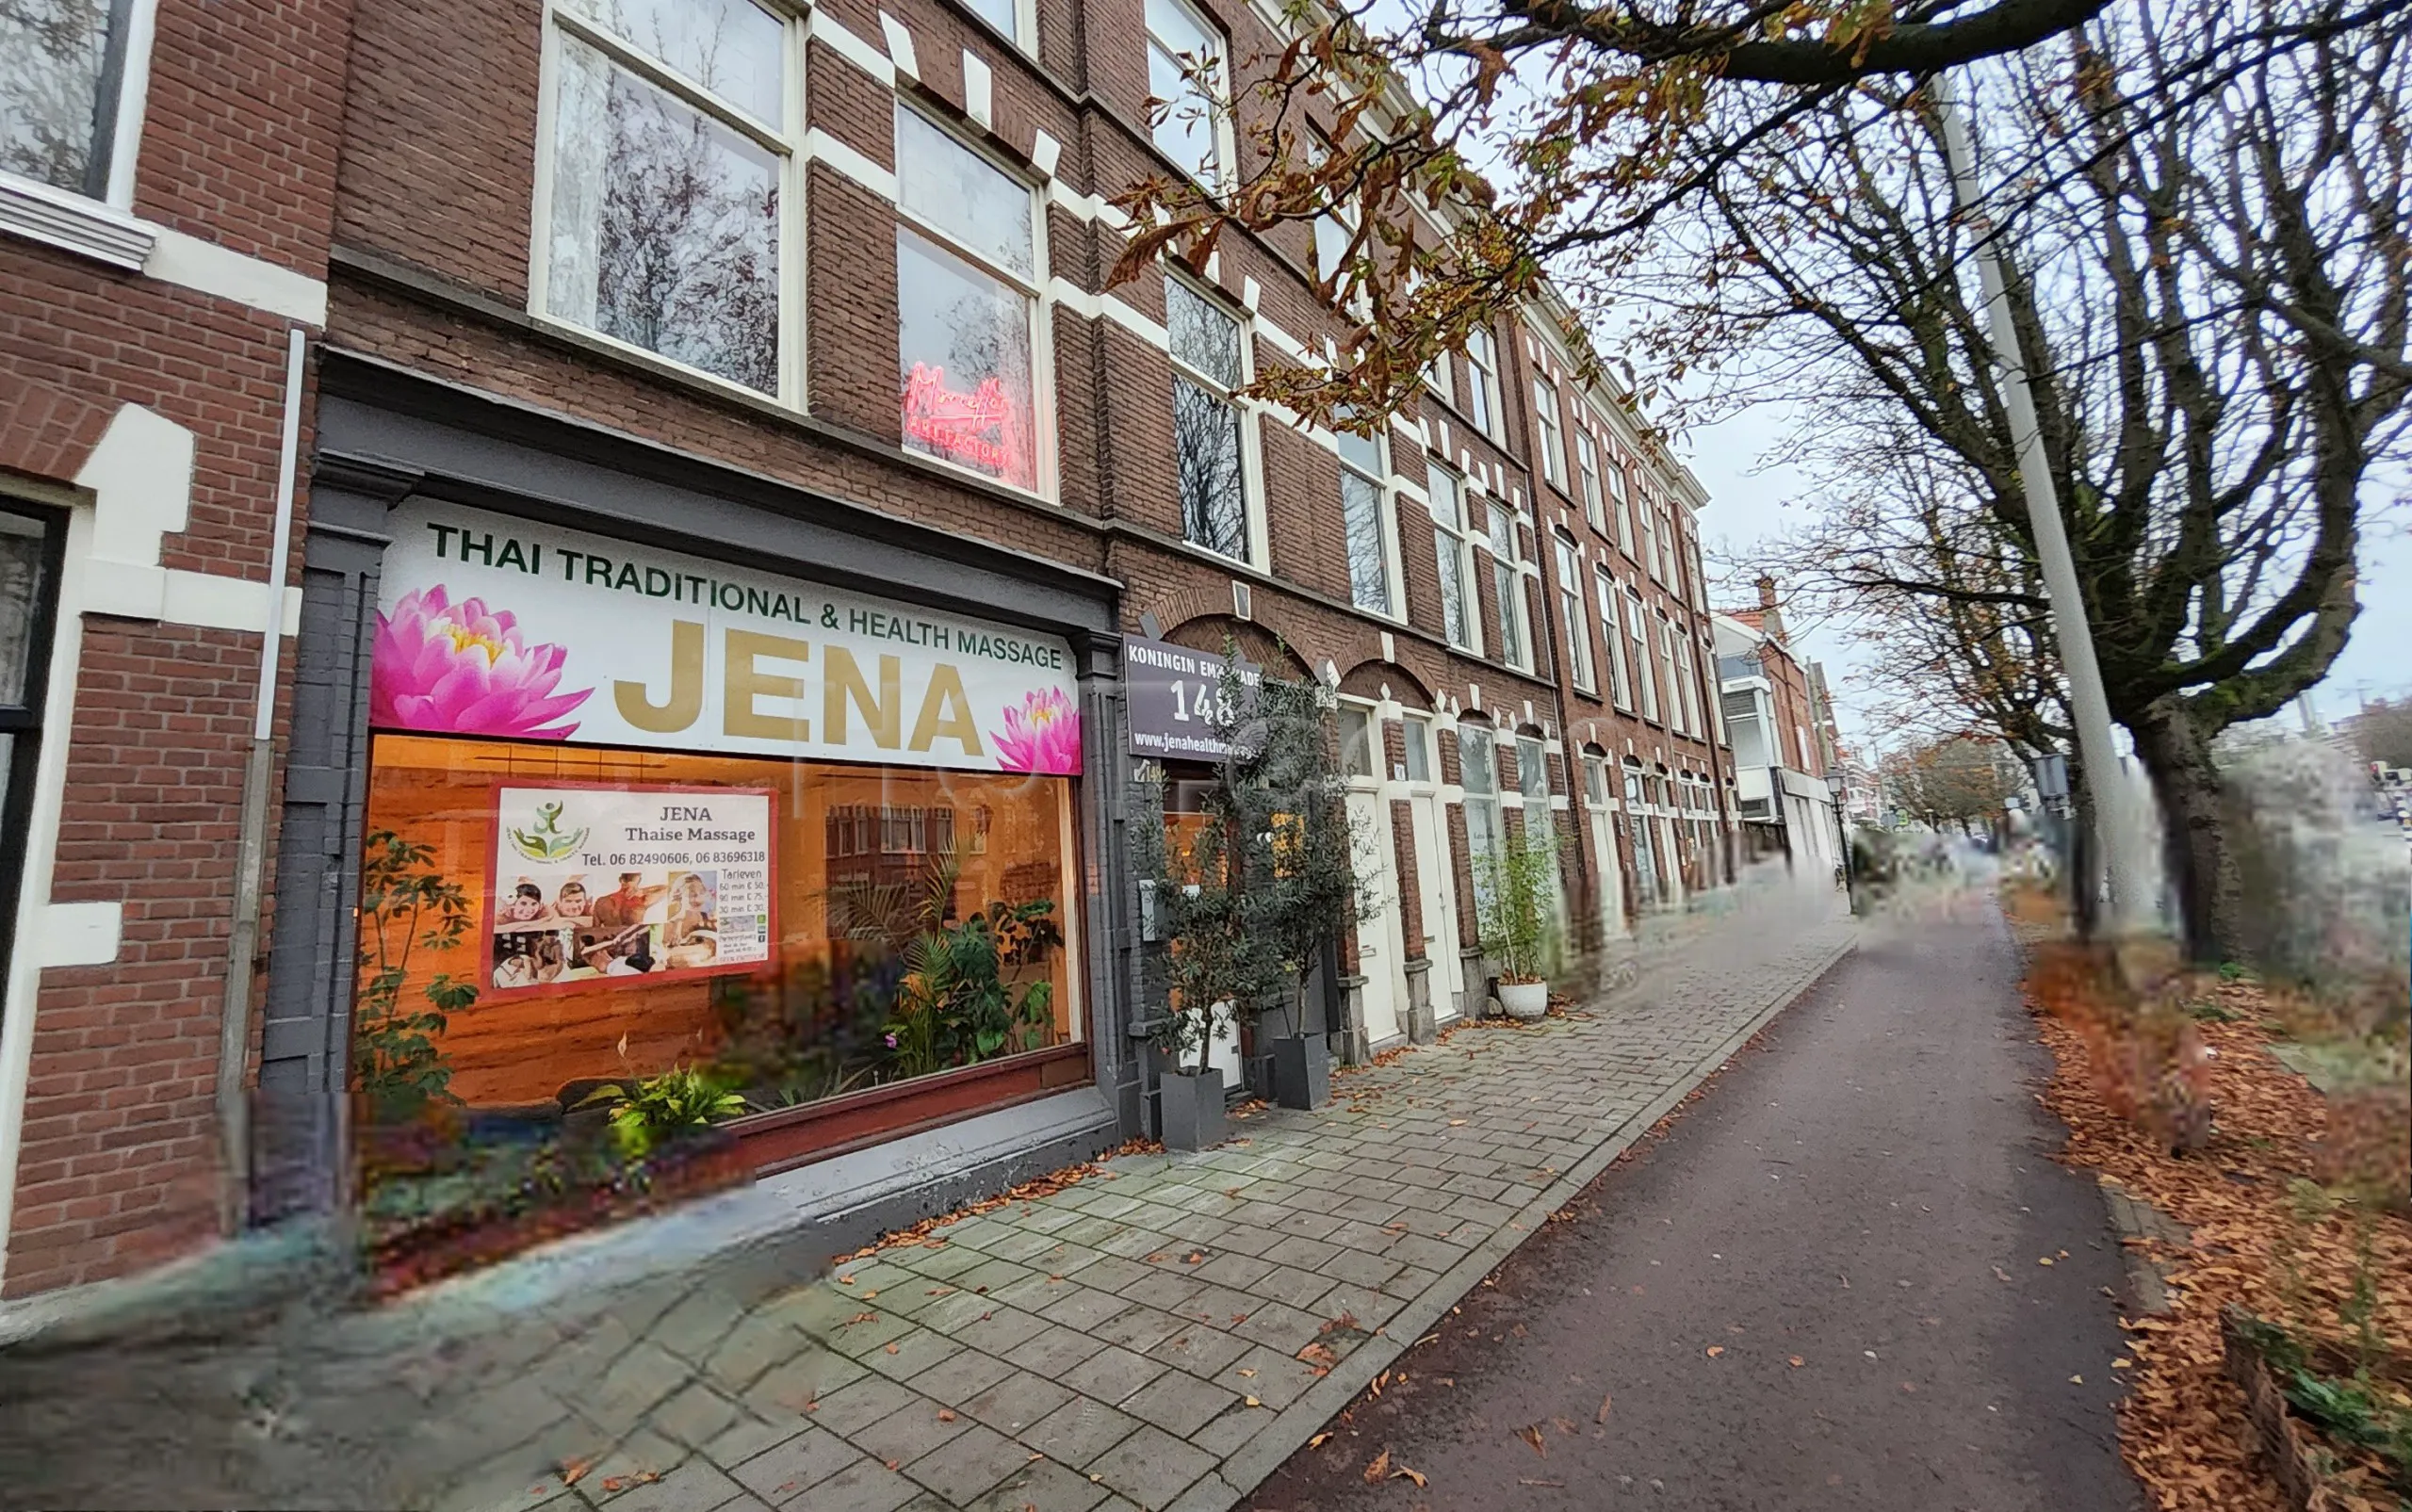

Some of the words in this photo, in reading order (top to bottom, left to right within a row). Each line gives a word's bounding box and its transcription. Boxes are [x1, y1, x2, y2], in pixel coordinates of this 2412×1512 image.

[945, 429, 1009, 465] FACTORY
[426, 522, 540, 576] THAI
[557, 547, 811, 624] TRADITIONAL
[820, 604, 839, 629] &
[849, 608, 949, 651] HEALTH
[956, 630, 1063, 671] MASSAGE
[1128, 644, 1196, 675] KONINGIN
[614, 619, 985, 756] JENA
[1170, 679, 1234, 727] 148
[660, 806, 712, 821] JENA
[626, 827, 685, 842] Thaise
[687, 828, 756, 844] Massage
[582, 854, 607, 867] Tel.
[610, 853, 627, 866] 06
[629, 852, 693, 866] 82490606,
[695, 852, 710, 864] 06
[712, 851, 765, 863] 83696318
[722, 868, 762, 880] Tarieven
